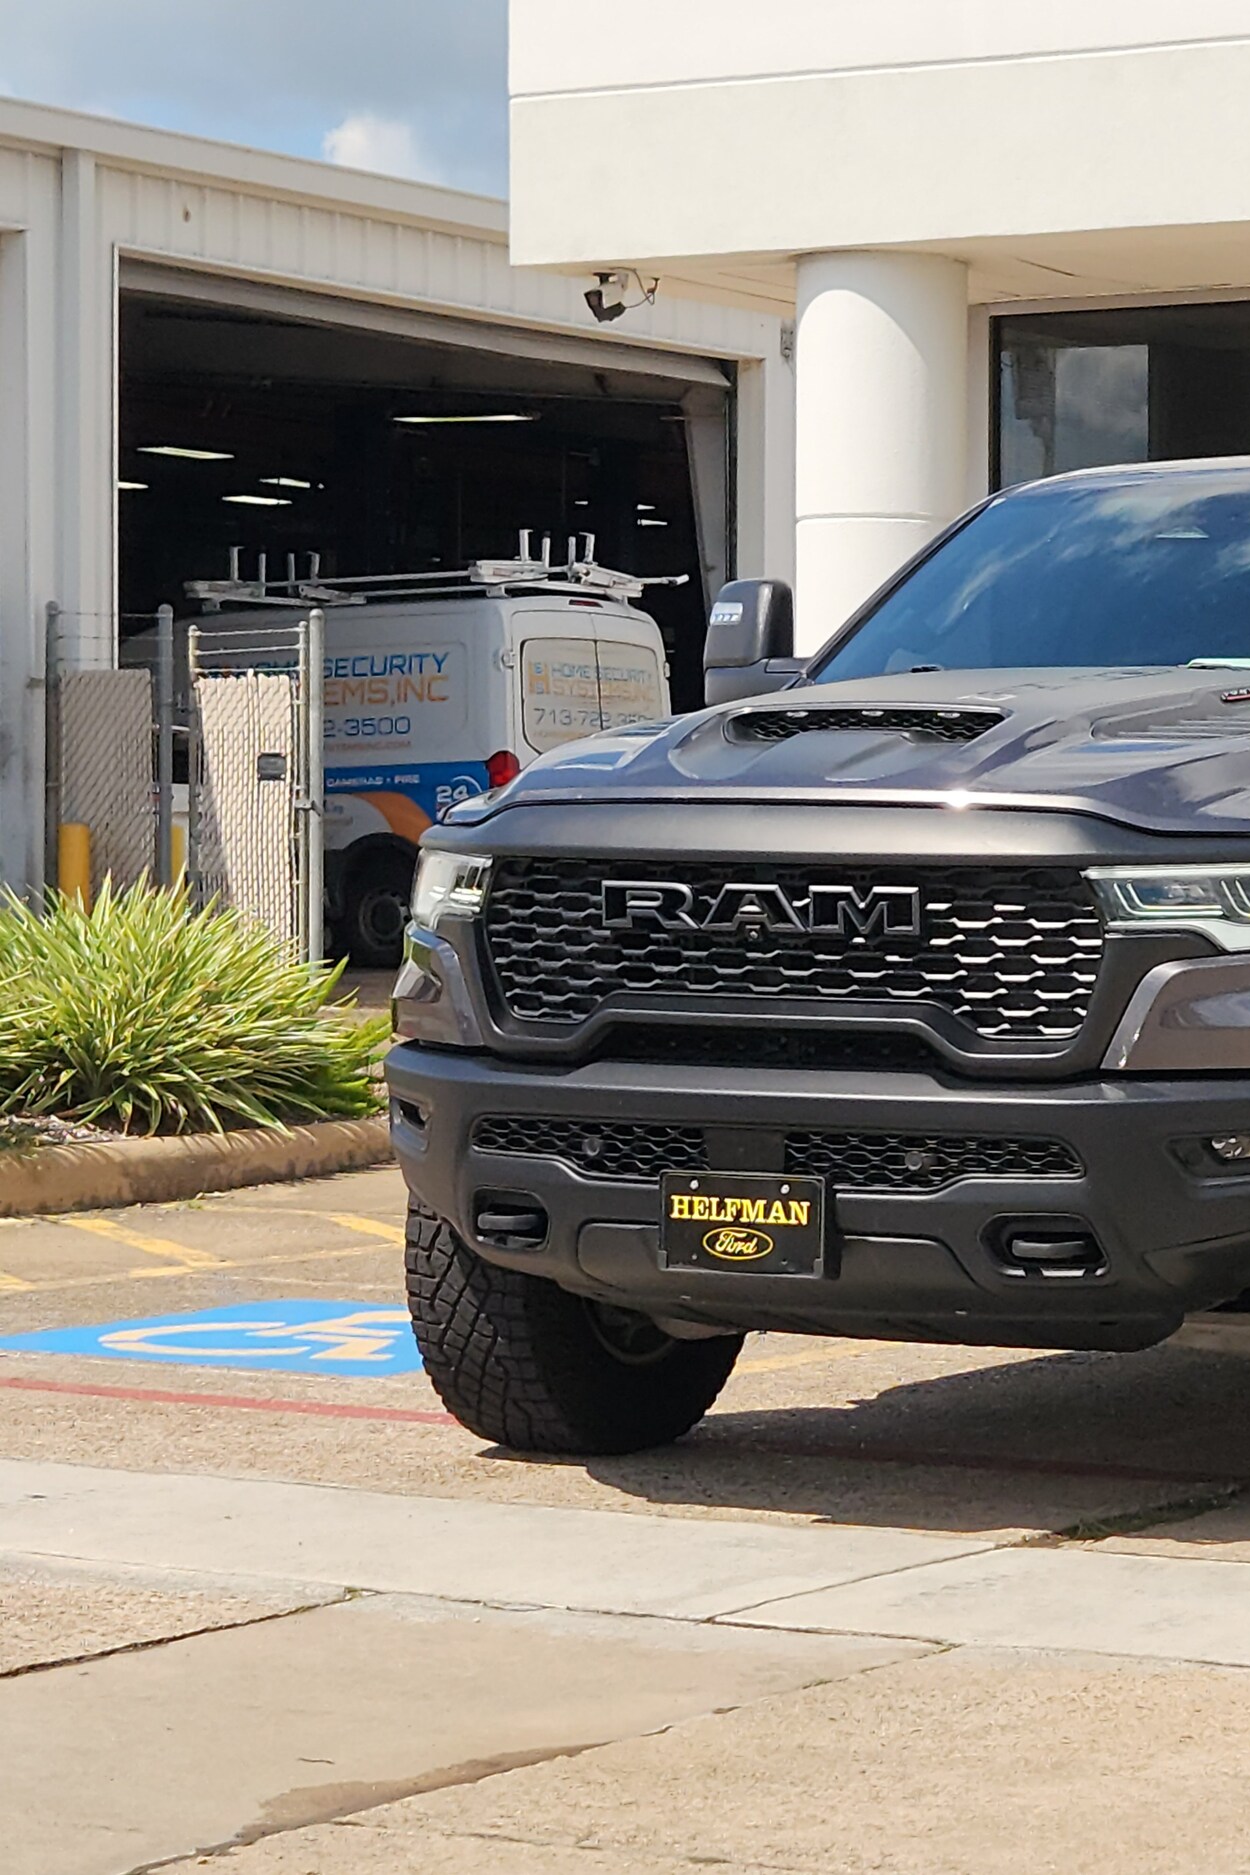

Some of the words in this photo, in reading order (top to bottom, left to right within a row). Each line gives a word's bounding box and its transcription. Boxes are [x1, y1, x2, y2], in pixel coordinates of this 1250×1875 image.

[323, 651, 450, 678] SECURITY
[551, 662, 591, 679] HOME
[323, 675, 449, 707] EMS,INC
[601, 879, 920, 935] RAM
[669, 1194, 812, 1227] HELFMAN
[715, 1230, 759, 1255] Ford
